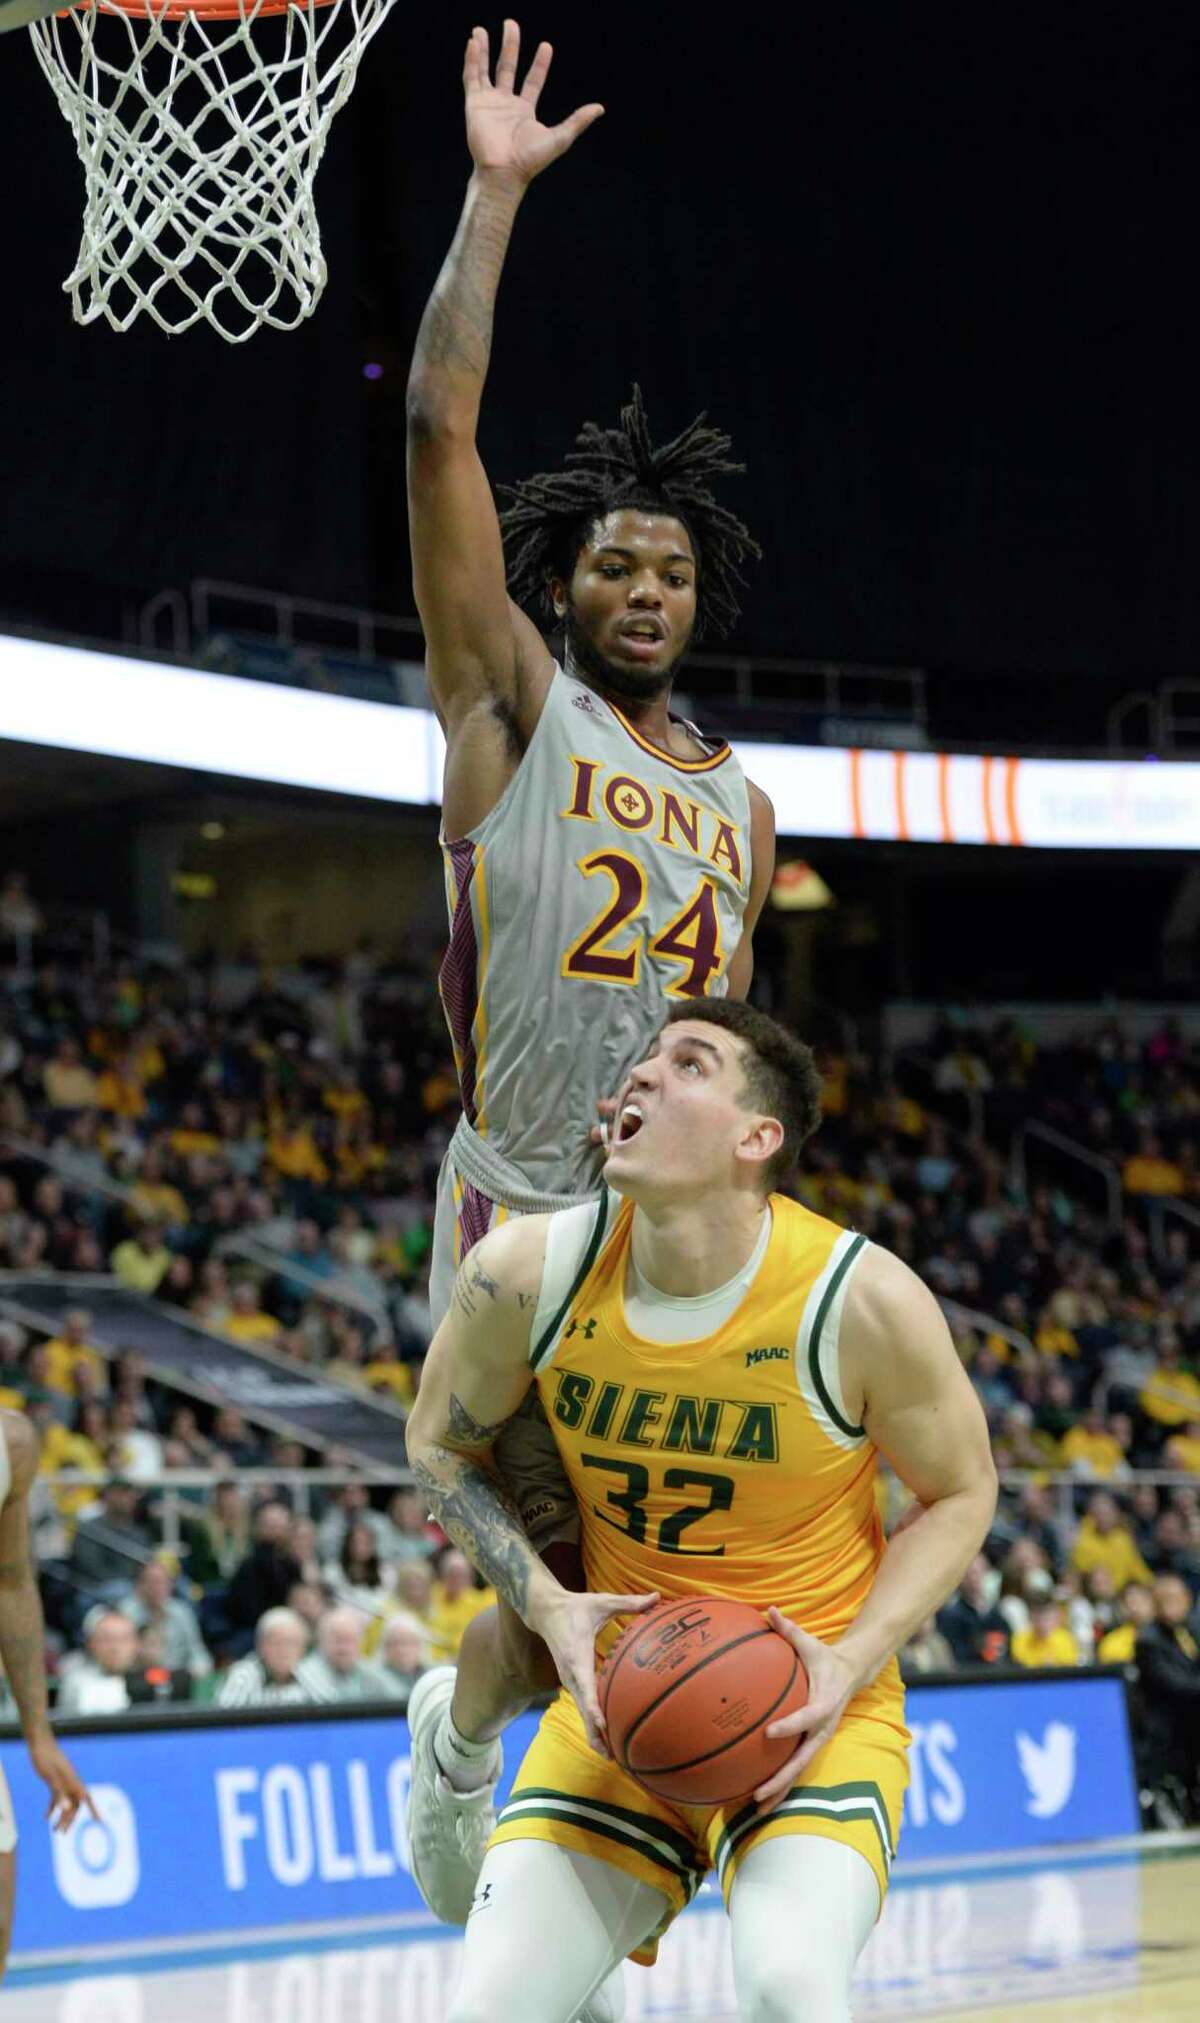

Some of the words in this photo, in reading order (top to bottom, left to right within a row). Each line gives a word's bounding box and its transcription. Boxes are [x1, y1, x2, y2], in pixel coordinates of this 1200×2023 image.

[560, 756, 743, 885] IONA
[561, 848, 724, 999] 24
[745, 1347, 790, 1368] MAAC
[551, 1367, 779, 1463] SIENA
[581, 1453, 734, 1556] 32
